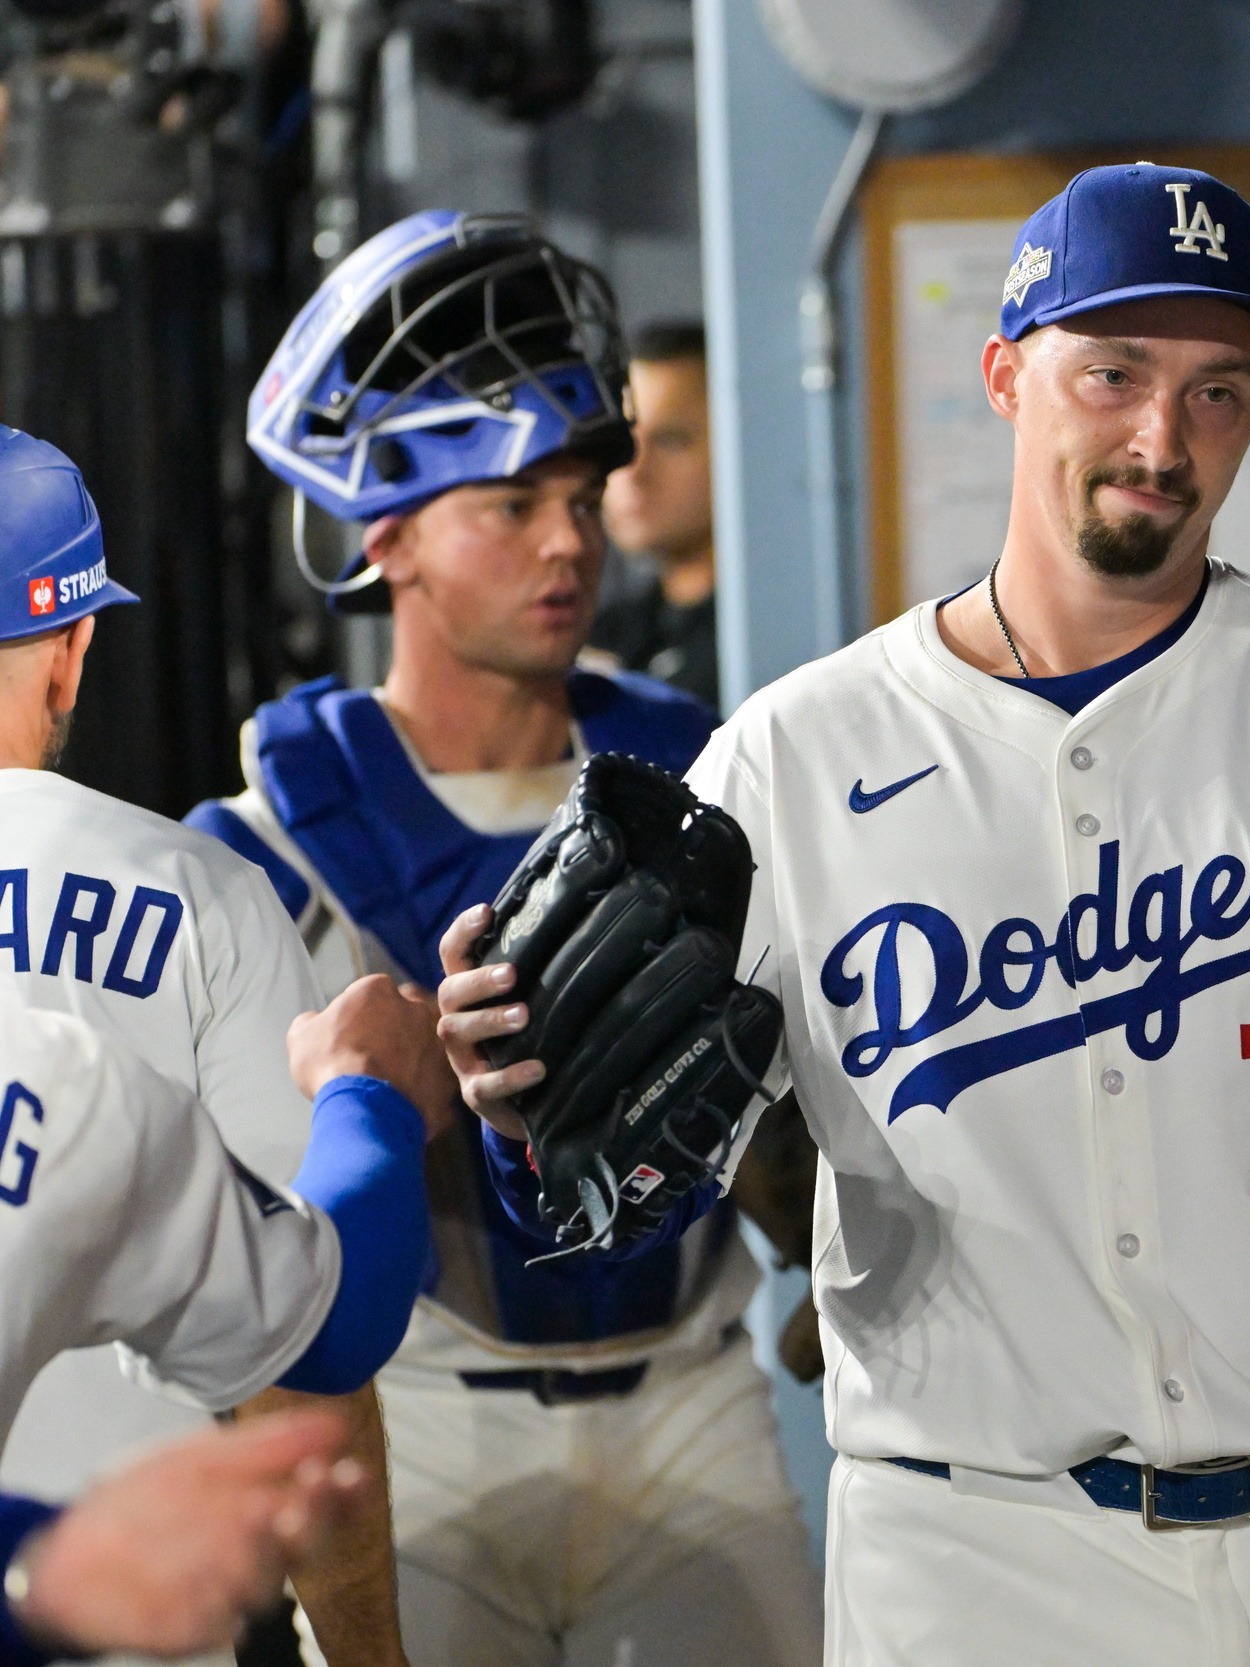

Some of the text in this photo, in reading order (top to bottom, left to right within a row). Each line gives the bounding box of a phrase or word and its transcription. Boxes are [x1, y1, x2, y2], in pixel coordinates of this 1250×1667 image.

[1165, 183, 1229, 262] LA
[1003, 259, 1048, 298] POSTSEASON
[0, 1081, 44, 1207] G
